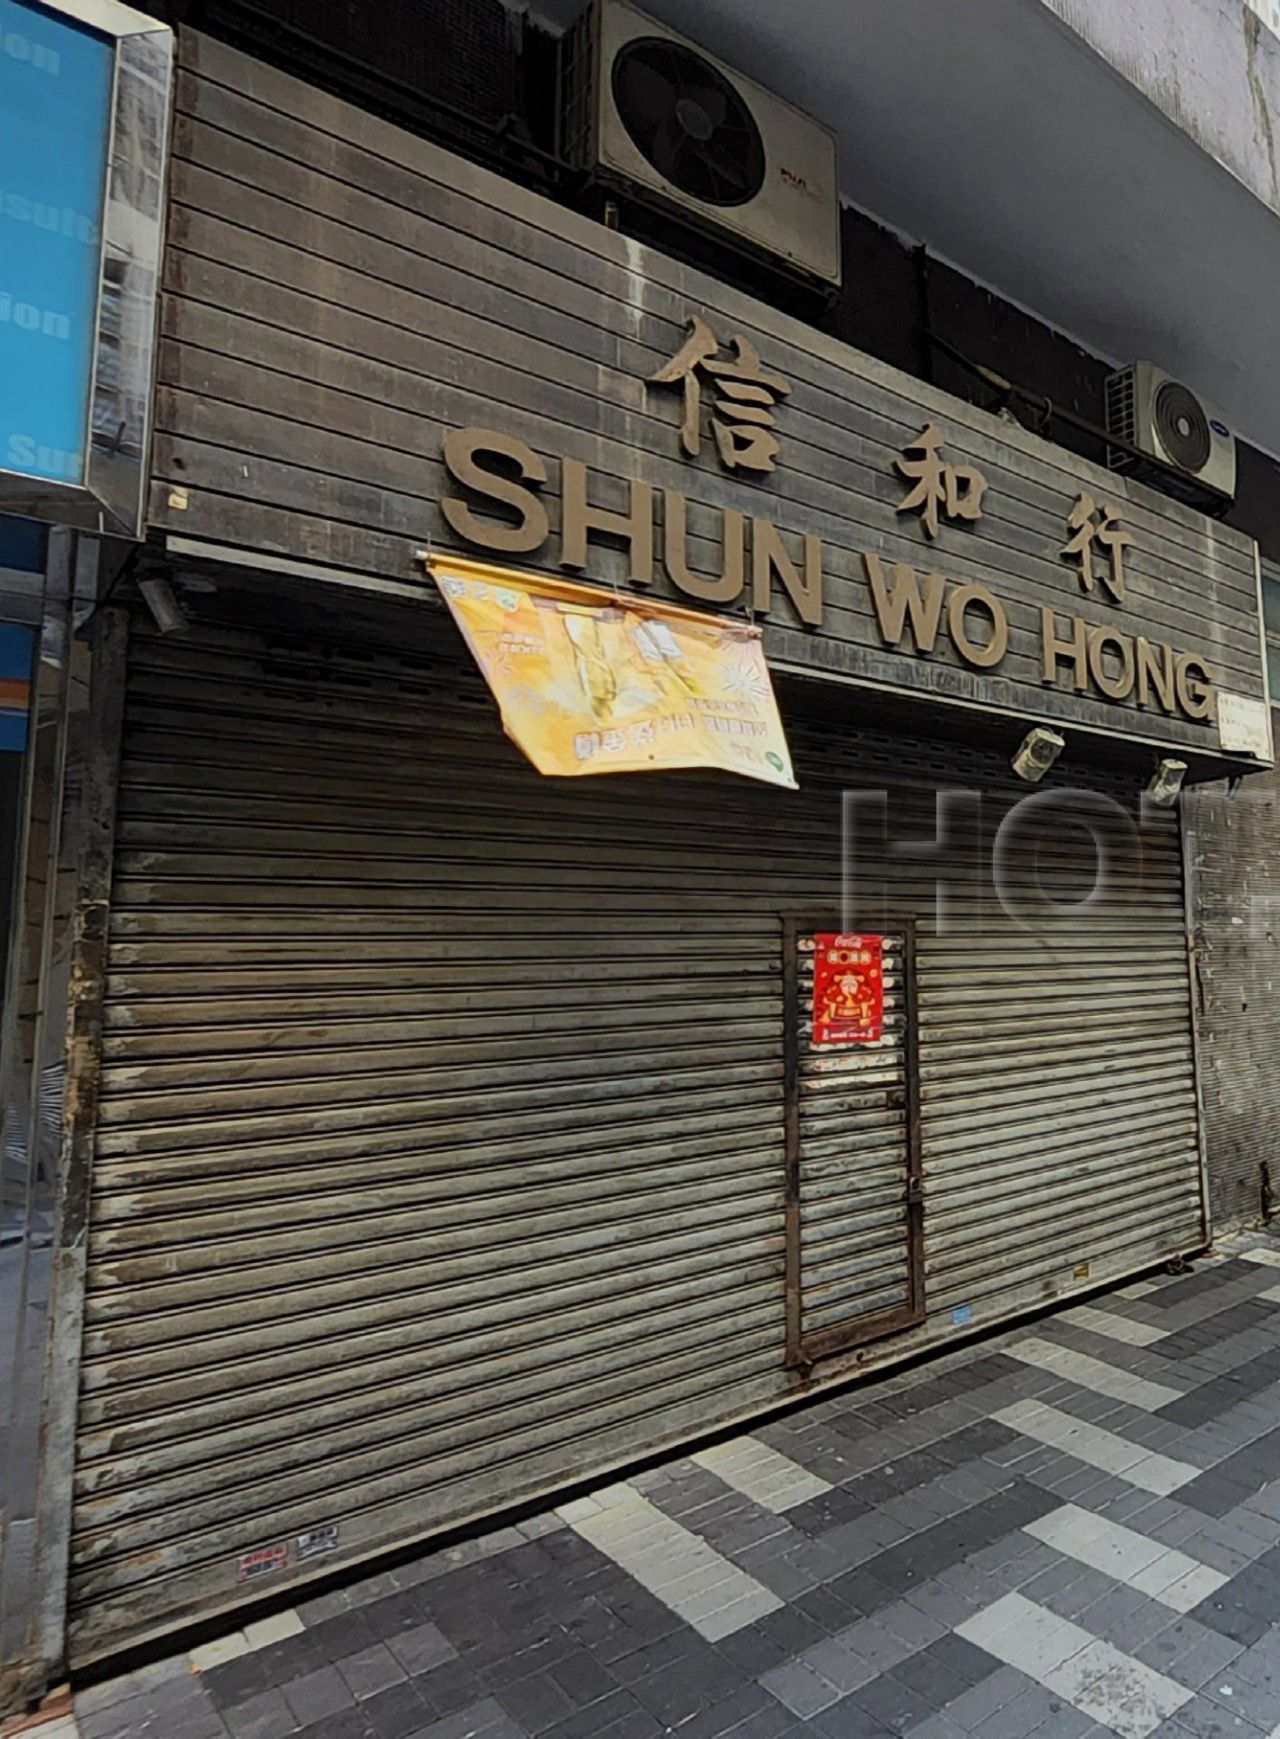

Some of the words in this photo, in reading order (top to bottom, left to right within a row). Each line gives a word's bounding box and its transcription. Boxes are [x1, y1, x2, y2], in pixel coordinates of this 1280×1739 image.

[440, 426, 823, 627] SHUN
[862, 551, 1009, 668] WO
[1040, 606, 1217, 723] HONG
[645, 315, 1136, 605] 信和行
